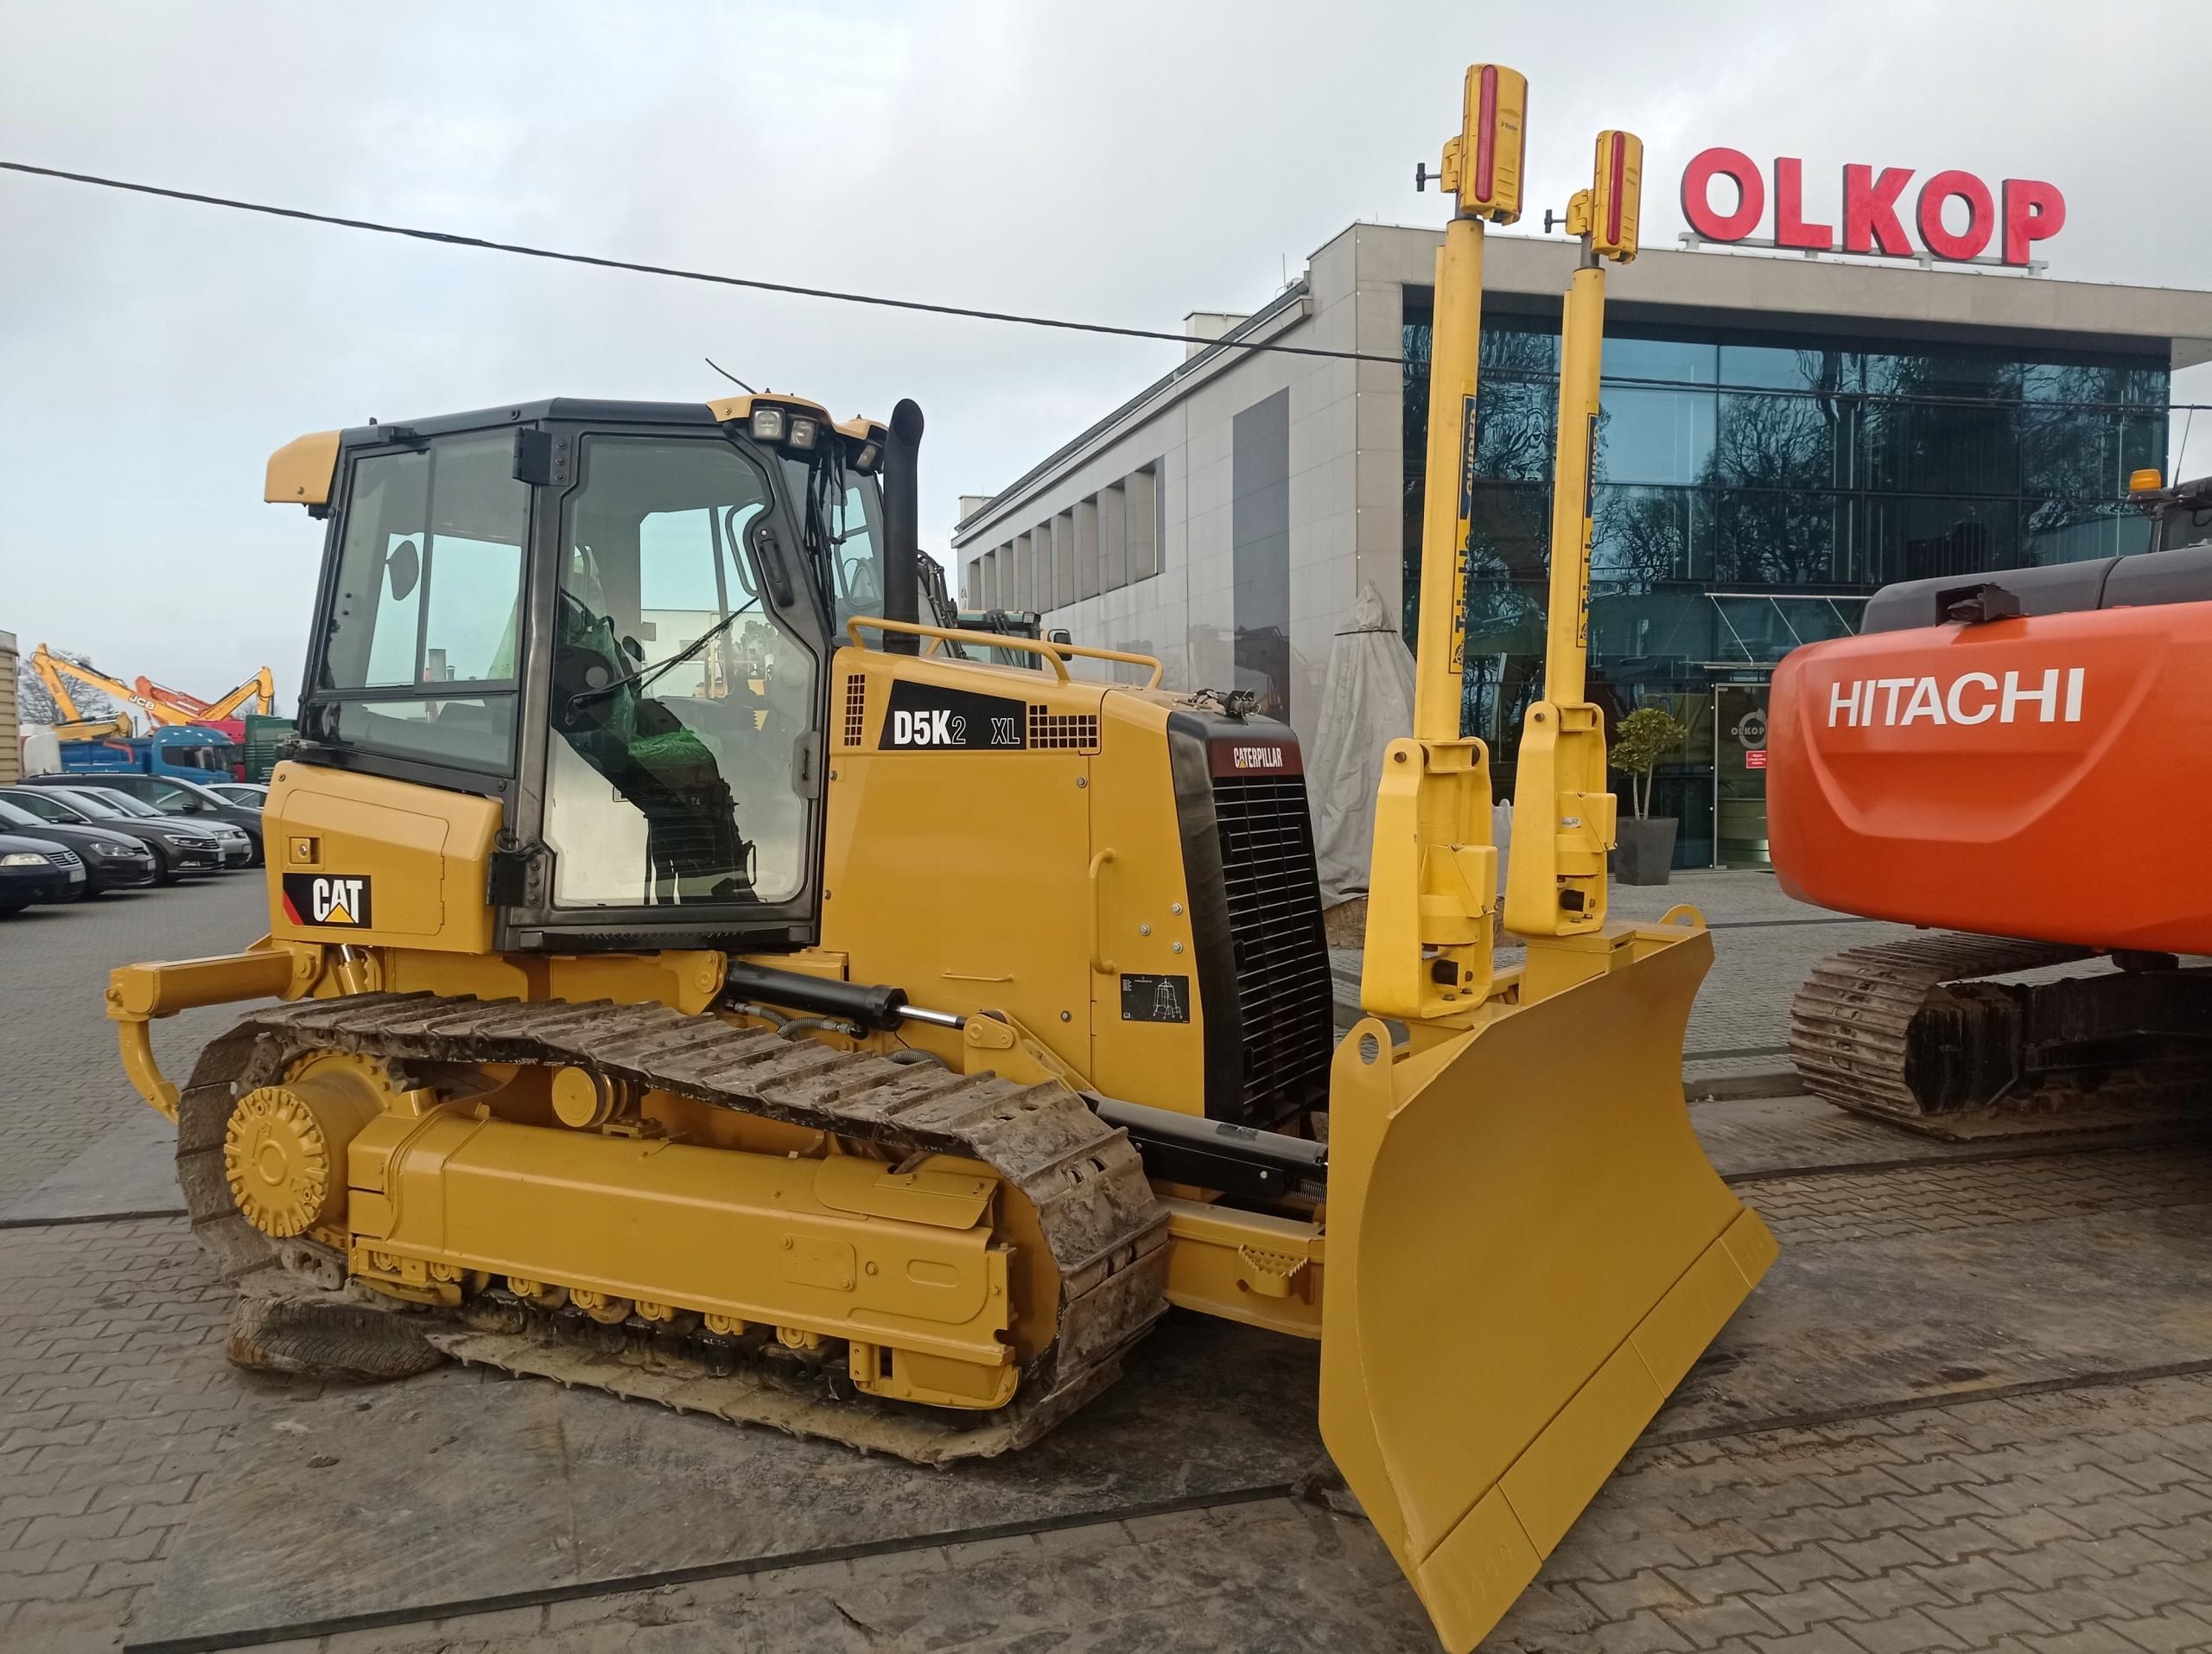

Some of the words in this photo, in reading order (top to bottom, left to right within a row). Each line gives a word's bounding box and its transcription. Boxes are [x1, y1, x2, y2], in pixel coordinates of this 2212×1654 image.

[1681, 147, 2066, 266] OLKOP
[129, 695, 156, 710] JCB
[1827, 667, 2085, 728] HITACHI
[893, 709, 967, 745] D5K2
[990, 717, 1020, 745] XL
[1731, 727, 1764, 735] OLKOP
[1233, 747, 1283, 768] CATERPILLAR
[313, 878, 363, 923] CAT
